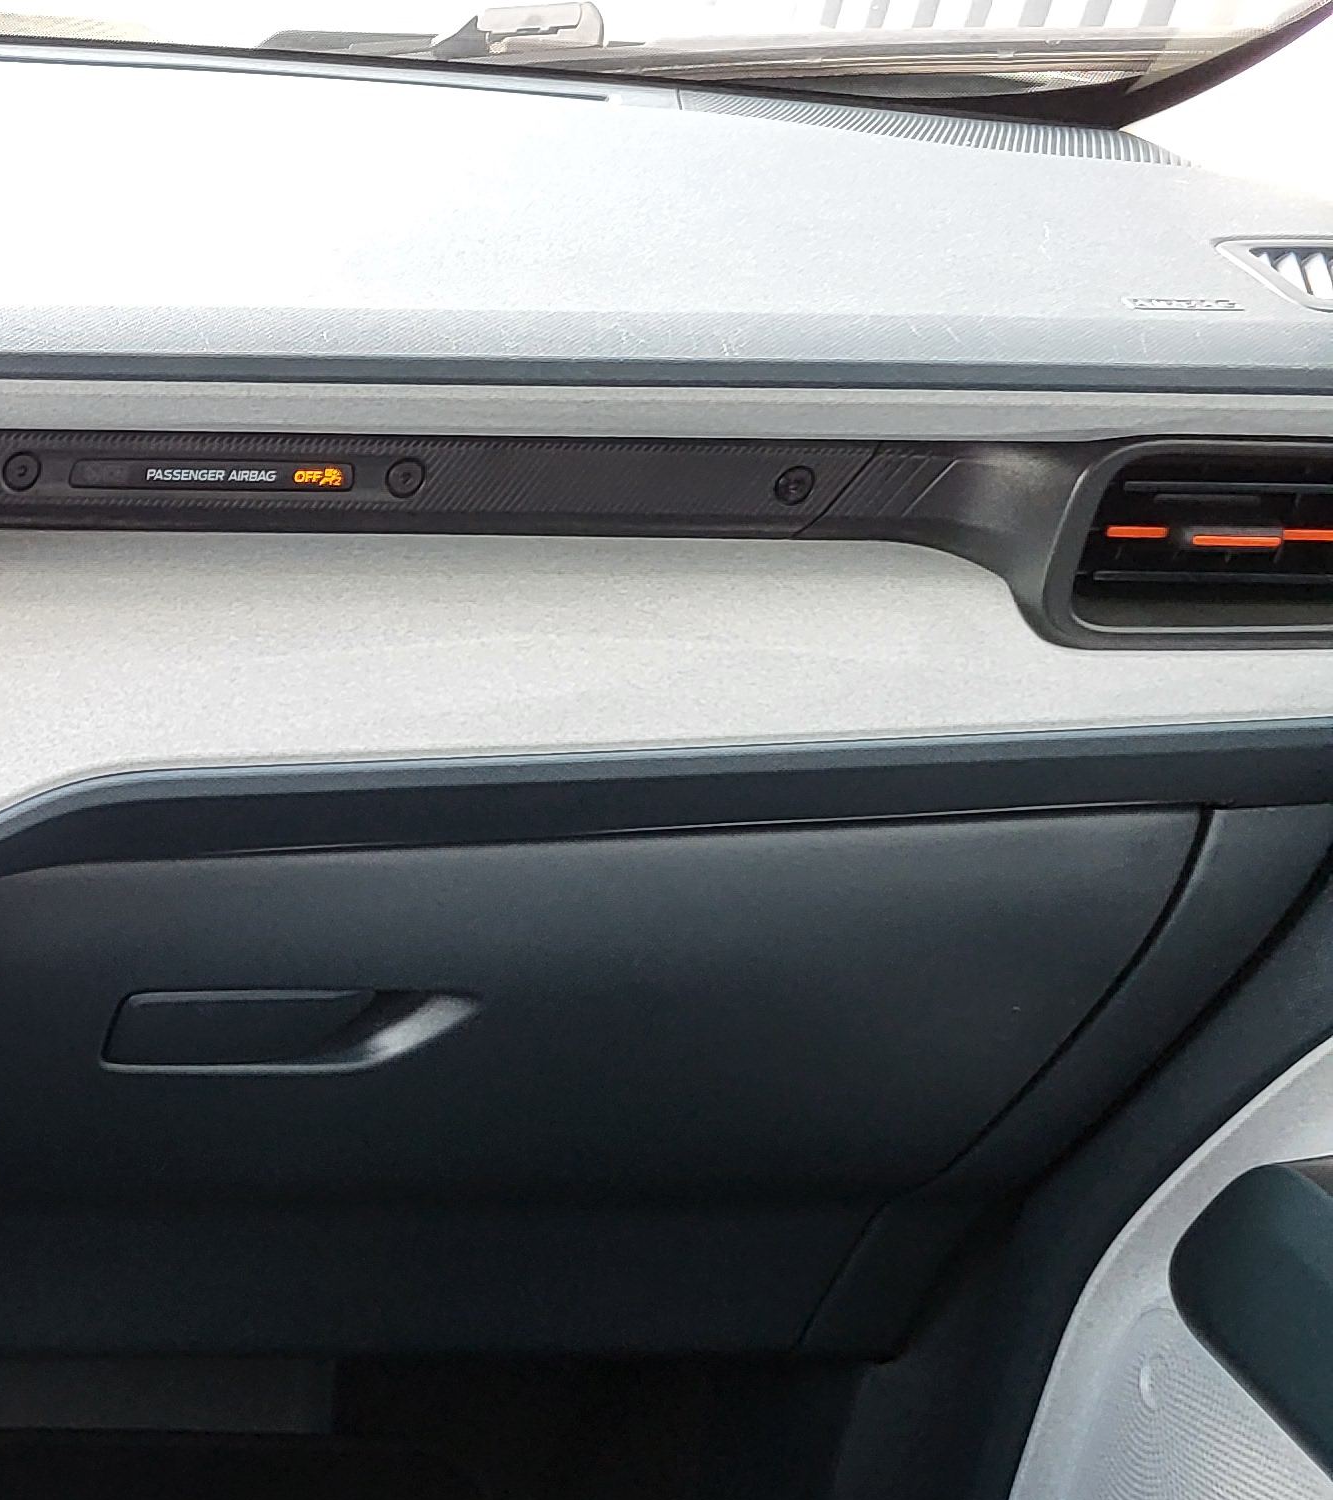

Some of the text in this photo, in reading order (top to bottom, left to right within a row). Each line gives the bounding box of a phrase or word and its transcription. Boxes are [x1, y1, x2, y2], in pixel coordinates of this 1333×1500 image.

[146, 468, 321, 483] PASSENGER AIRBAG OFF
